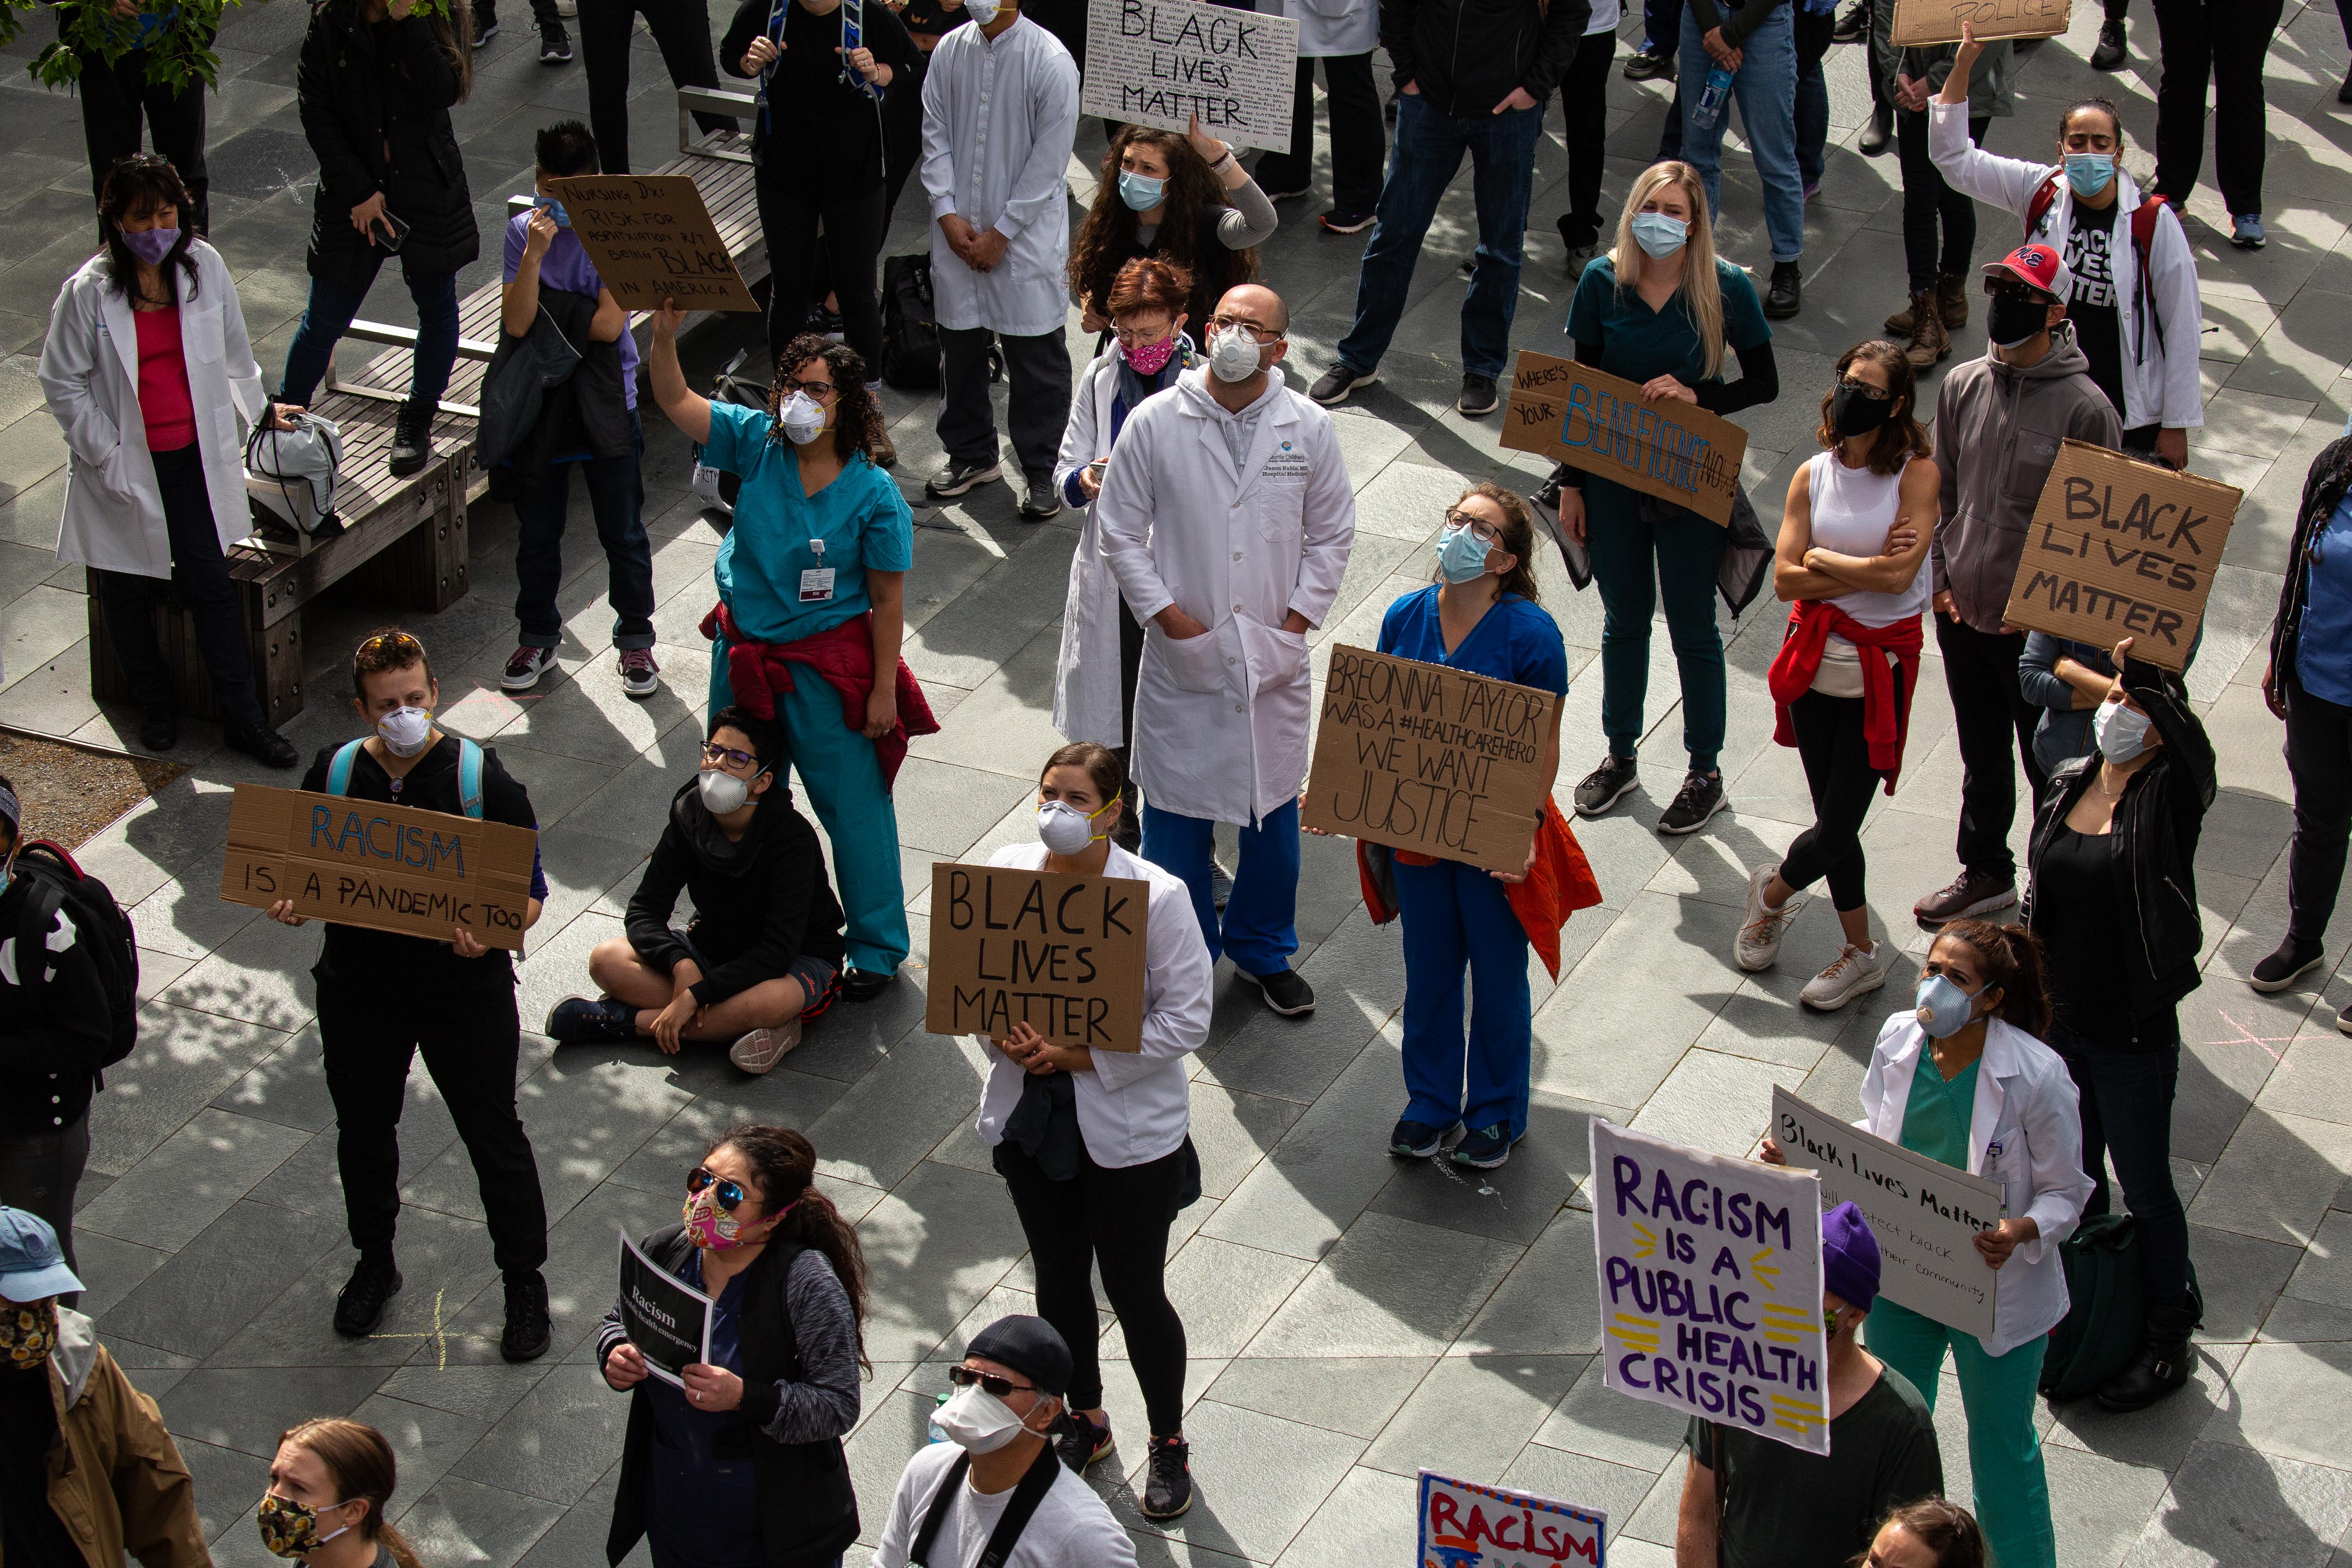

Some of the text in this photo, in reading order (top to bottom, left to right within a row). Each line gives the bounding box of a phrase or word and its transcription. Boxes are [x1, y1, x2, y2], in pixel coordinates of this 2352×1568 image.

[1122, 0, 1258, 59] BLACK
[1195, 4, 1291, 27] MICHAEL BROWN EZELL FORD
[1247, 22, 1269, 31] GEORGE
[1950, 0, 2056, 30] POLICE
[1152, 52, 1233, 88] LIVES
[1700, 86, 1712, 106] smart
[1122, 85, 1248, 125] MATTER
[563, 184, 633, 203] NURSING
[582, 208, 675, 227] RISK FOR
[587, 230, 707, 247] ASPHYXIATION R/T
[608, 247, 736, 275] BEING BLACK
[619, 279, 729, 296] IN AMERICA
[1517, 365, 1568, 390] WHERE'S
[1514, 403, 1556, 426] YOUR
[1561, 382, 1711, 493] BENEFICENCE
[2064, 476, 2208, 555] BLACK
[2040, 522, 2197, 592] LIVES
[2022, 570, 2183, 646] MATTER
[1327, 652, 1545, 744] BREONNA TAYLOR
[1324, 693, 1537, 764] WAS A #HEALTHCAREHERO
[1356, 731, 1498, 793] WE WANT
[310, 804, 465, 879] RACISM
[1333, 769, 1488, 856] JUSTICE
[244, 863, 522, 931] IS A PANDEMIC TOO
[950, 870, 1133, 939] BLACK
[978, 937, 1096, 984] LIVES
[953, 984, 1112, 1043] MATTER
[1613, 1154, 1791, 1250] RACISM
[1780, 1113, 1994, 1232] Black Lives Matter
[1665, 1227, 1742, 1281] IS A
[1879, 1244, 1985, 1304] their community
[1910, 1229, 1955, 1263] black
[632, 1285, 676, 1329] Racism
[1606, 1256, 1756, 1332] PUBLIC
[638, 1310, 658, 1331] health
[658, 1327, 698, 1353] emergency
[1677, 1322, 1818, 1392] HEALTH
[1618, 1351, 1766, 1427] CRISIS
